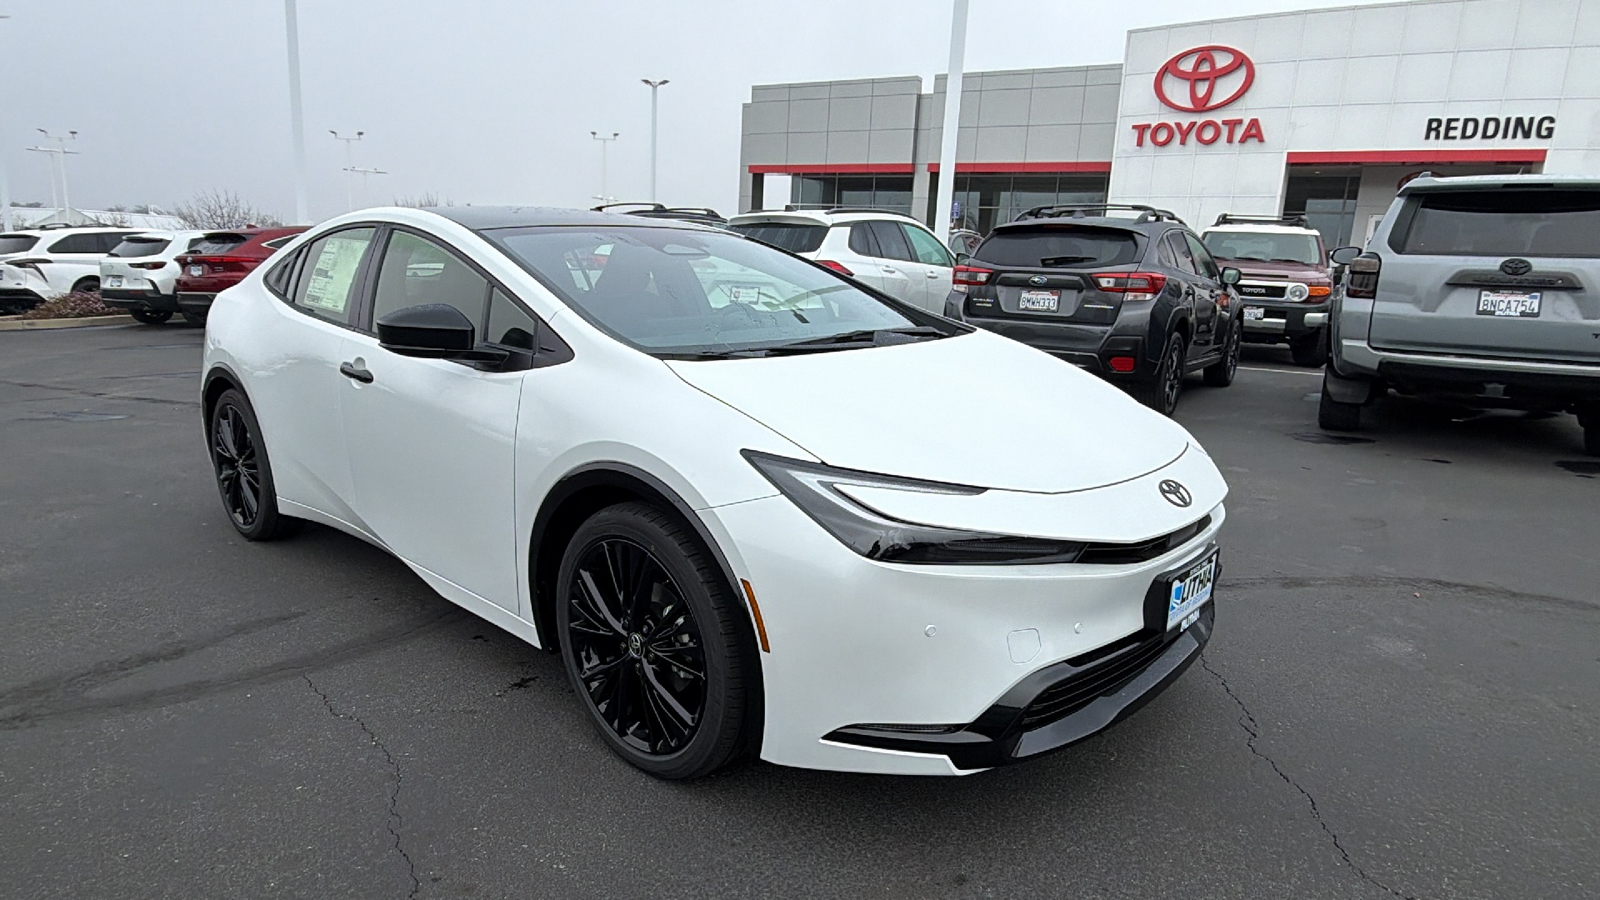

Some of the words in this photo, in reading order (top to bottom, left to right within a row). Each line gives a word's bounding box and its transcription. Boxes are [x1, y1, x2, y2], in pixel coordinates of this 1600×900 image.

[1131, 117, 1265, 147] TOYOTA
[1424, 115, 1556, 141] REDDING
[1021, 296, 1056, 309] 8MWH333
[1481, 299, 1537, 314] 8NCA754
[1180, 563, 1213, 603] LITHIA
